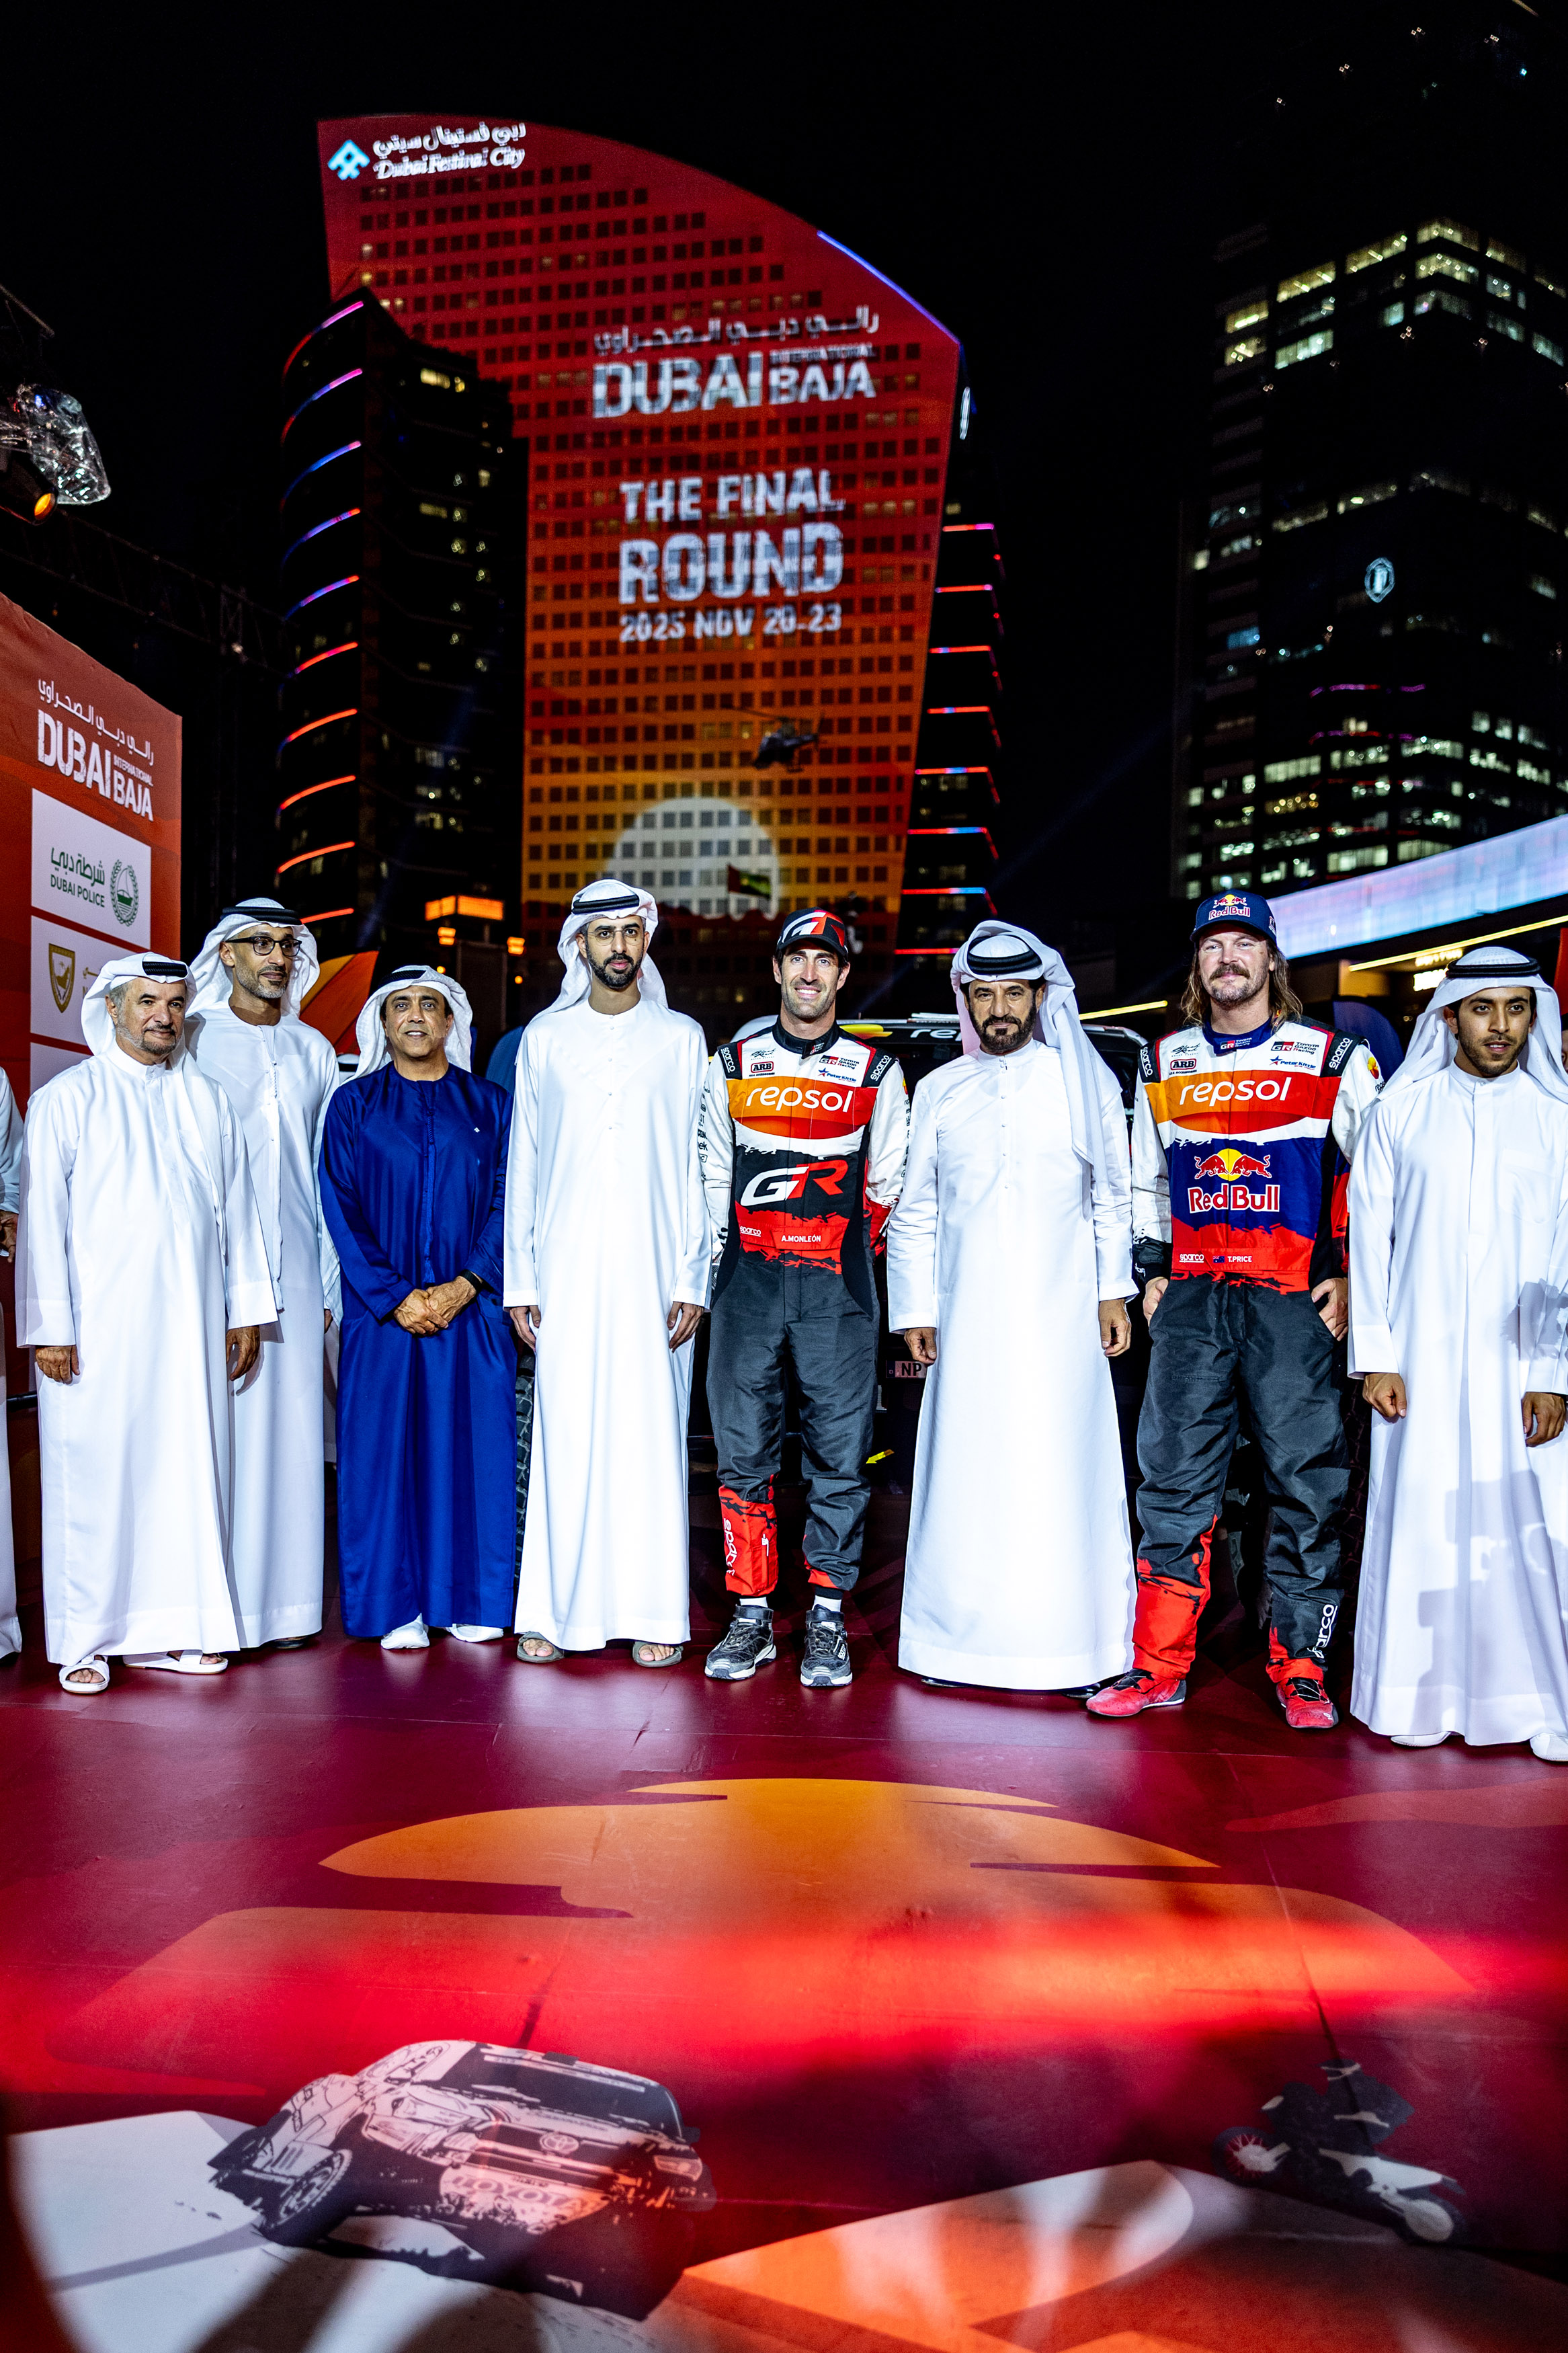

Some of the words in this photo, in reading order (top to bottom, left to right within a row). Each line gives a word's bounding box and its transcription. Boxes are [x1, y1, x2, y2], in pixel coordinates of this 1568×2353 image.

[372, 154, 429, 180] Dubai
[428, 147, 489, 174] Festival
[489, 146, 525, 169] City
[725, 317, 800, 346] دبي
[592, 350, 764, 419] DUBAI
[768, 360, 877, 405] BAJA
[620, 476, 703, 524] THE
[716, 467, 846, 520] FINAL
[618, 521, 844, 604] ROUND
[620, 610, 686, 643] 2025
[693, 606, 755, 639] NOV
[38, 678, 94, 725] الصحراوي
[95, 715, 126, 748] دبي
[38, 709, 111, 799] DUBAI
[126, 735, 154, 766] رالي
[113, 754, 153, 787] INTERNATIONAL
[113, 768, 154, 822] BAJA
[51, 847, 75, 875] دبي
[75, 853, 105, 887] شرطة
[50, 873, 75, 896] DUBAI
[77, 885, 105, 908] POLICE
[1208, 907, 1228, 920] Red
[1229, 906, 1251, 918] Bull
[720, 1047, 736, 1073] sparco
[753, 1063, 772, 1071] ARB
[870, 1055, 892, 1081] sparco
[1140, 1047, 1153, 1077] sparco
[1173, 1060, 1194, 1068] ARB
[1329, 1038, 1353, 1070] sparco
[745, 1086, 854, 1113] repsol
[1180, 1076, 1292, 1107] repsol
[740, 1159, 848, 1207] GR
[1188, 1183, 1229, 1213] Red
[1231, 1184, 1280, 1212] Bull
[740, 1226, 761, 1237] sparco
[781, 1234, 821, 1242] A.MONLEÓN
[1180, 1254, 1204, 1263] sparco
